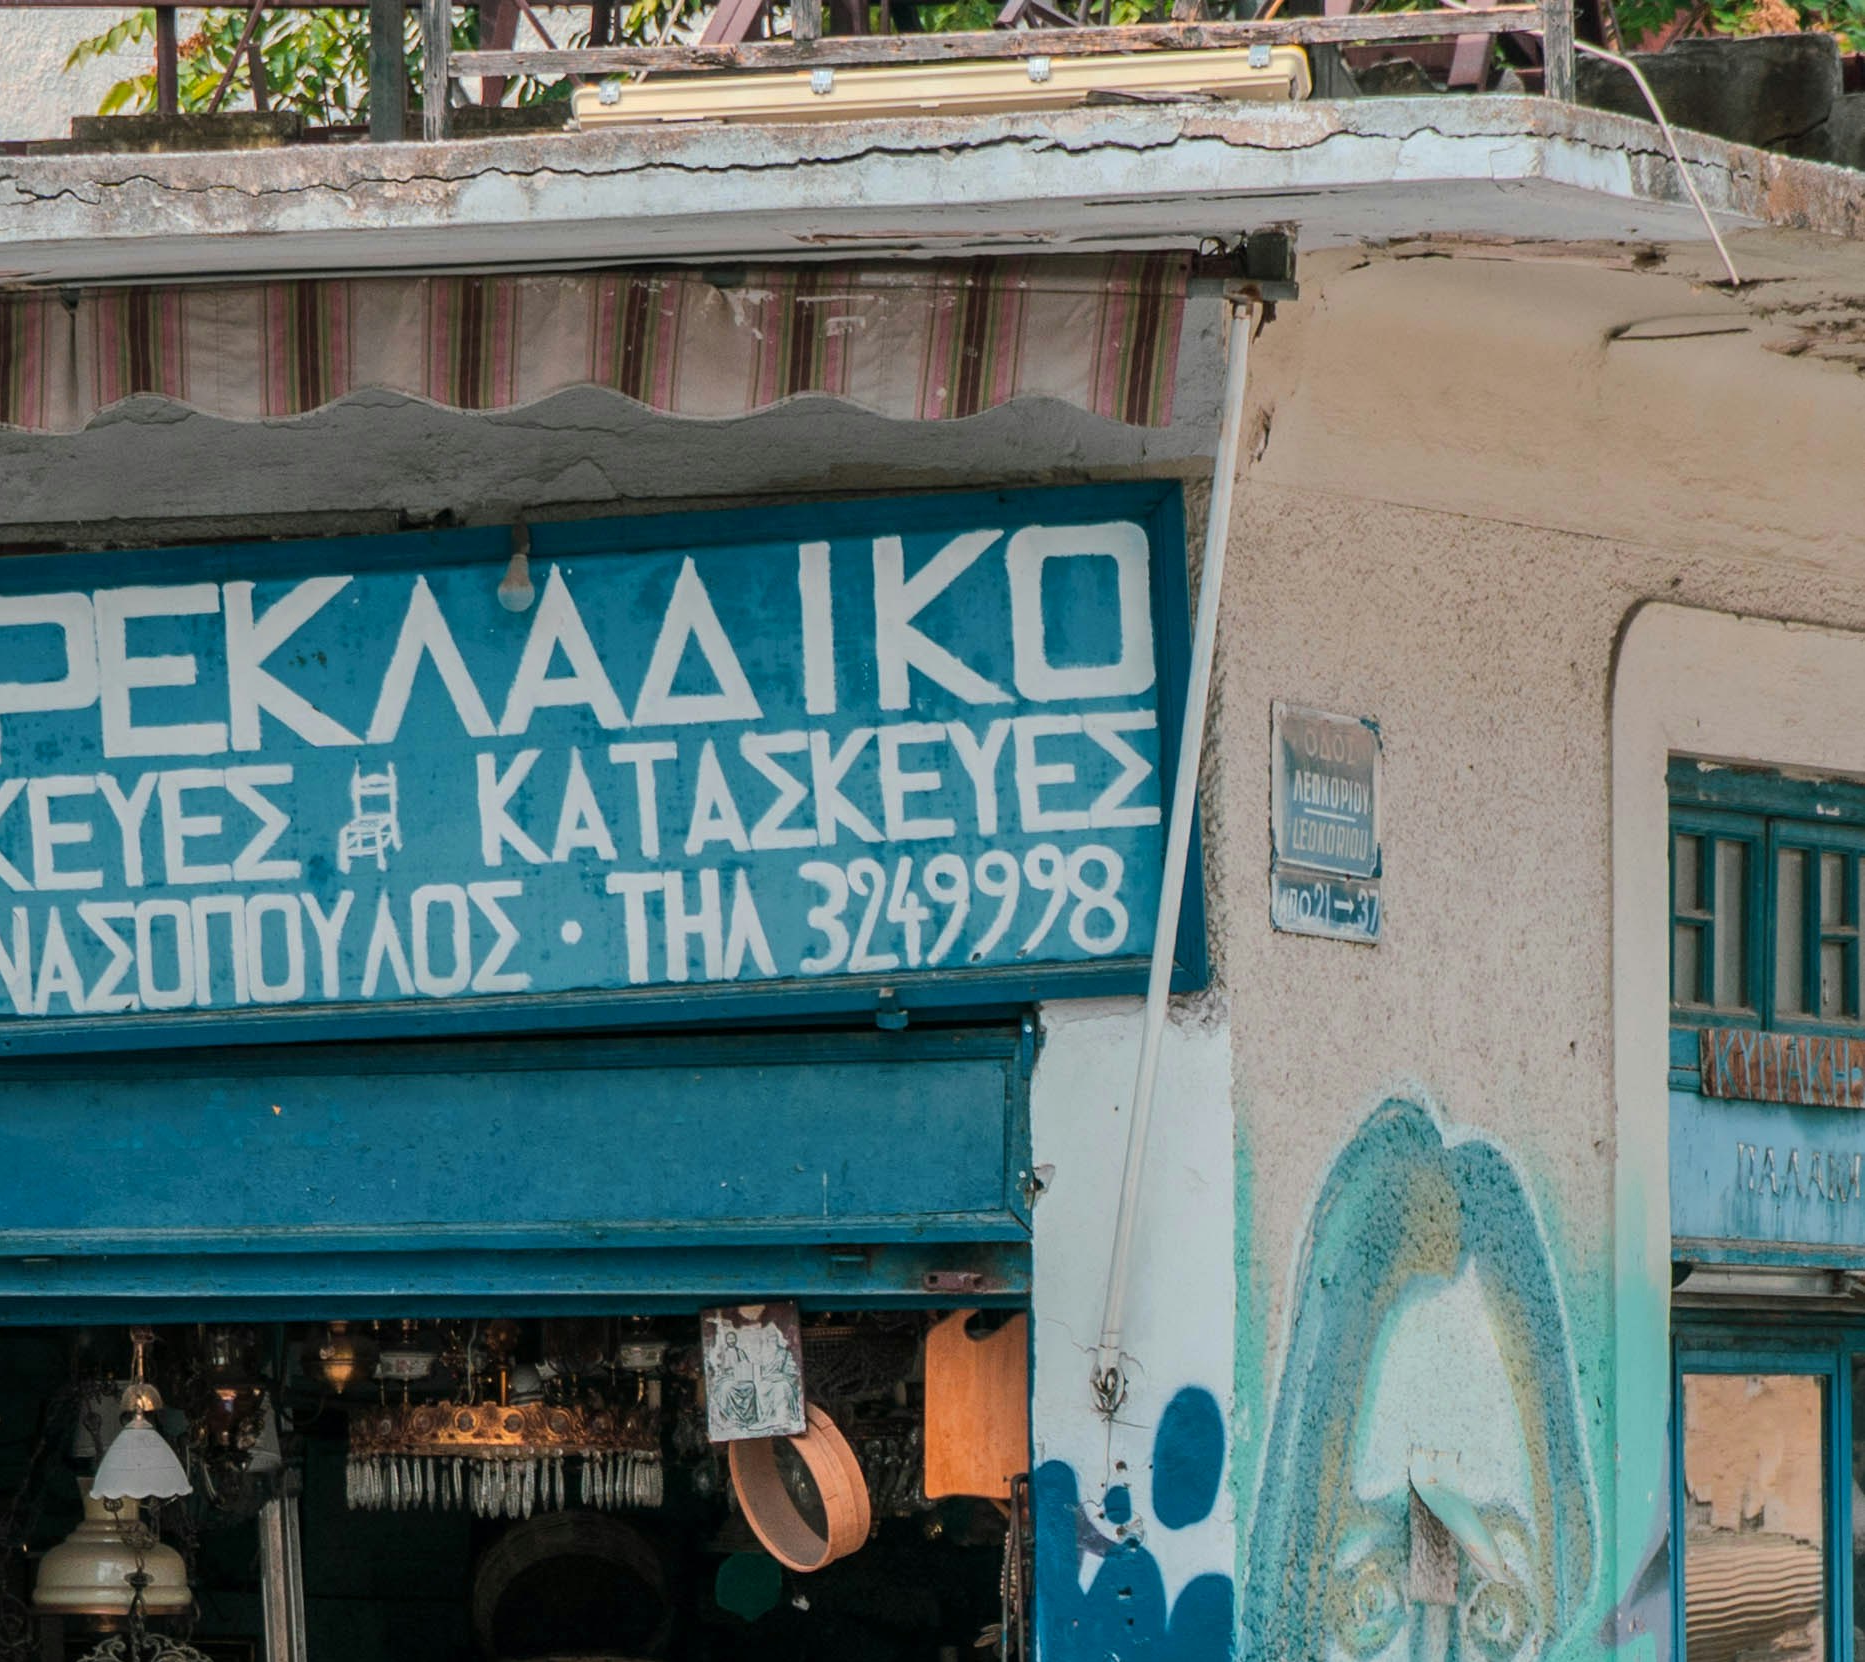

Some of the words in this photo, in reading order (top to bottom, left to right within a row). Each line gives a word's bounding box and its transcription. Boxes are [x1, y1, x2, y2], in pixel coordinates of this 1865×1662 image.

[476, 709, 1162, 868] ΚΑΤΑΣΚΕΥΕΣ
[1293, 768, 1371, 815] ΛΕΩΚΟΡΙΟΥ
[1292, 816, 1369, 861] LEOKORIOU
[606, 866, 778, 985] ΤΗΛ
[799, 842, 1129, 975] 3249998
[1358, 887, 1380, 937] 37
